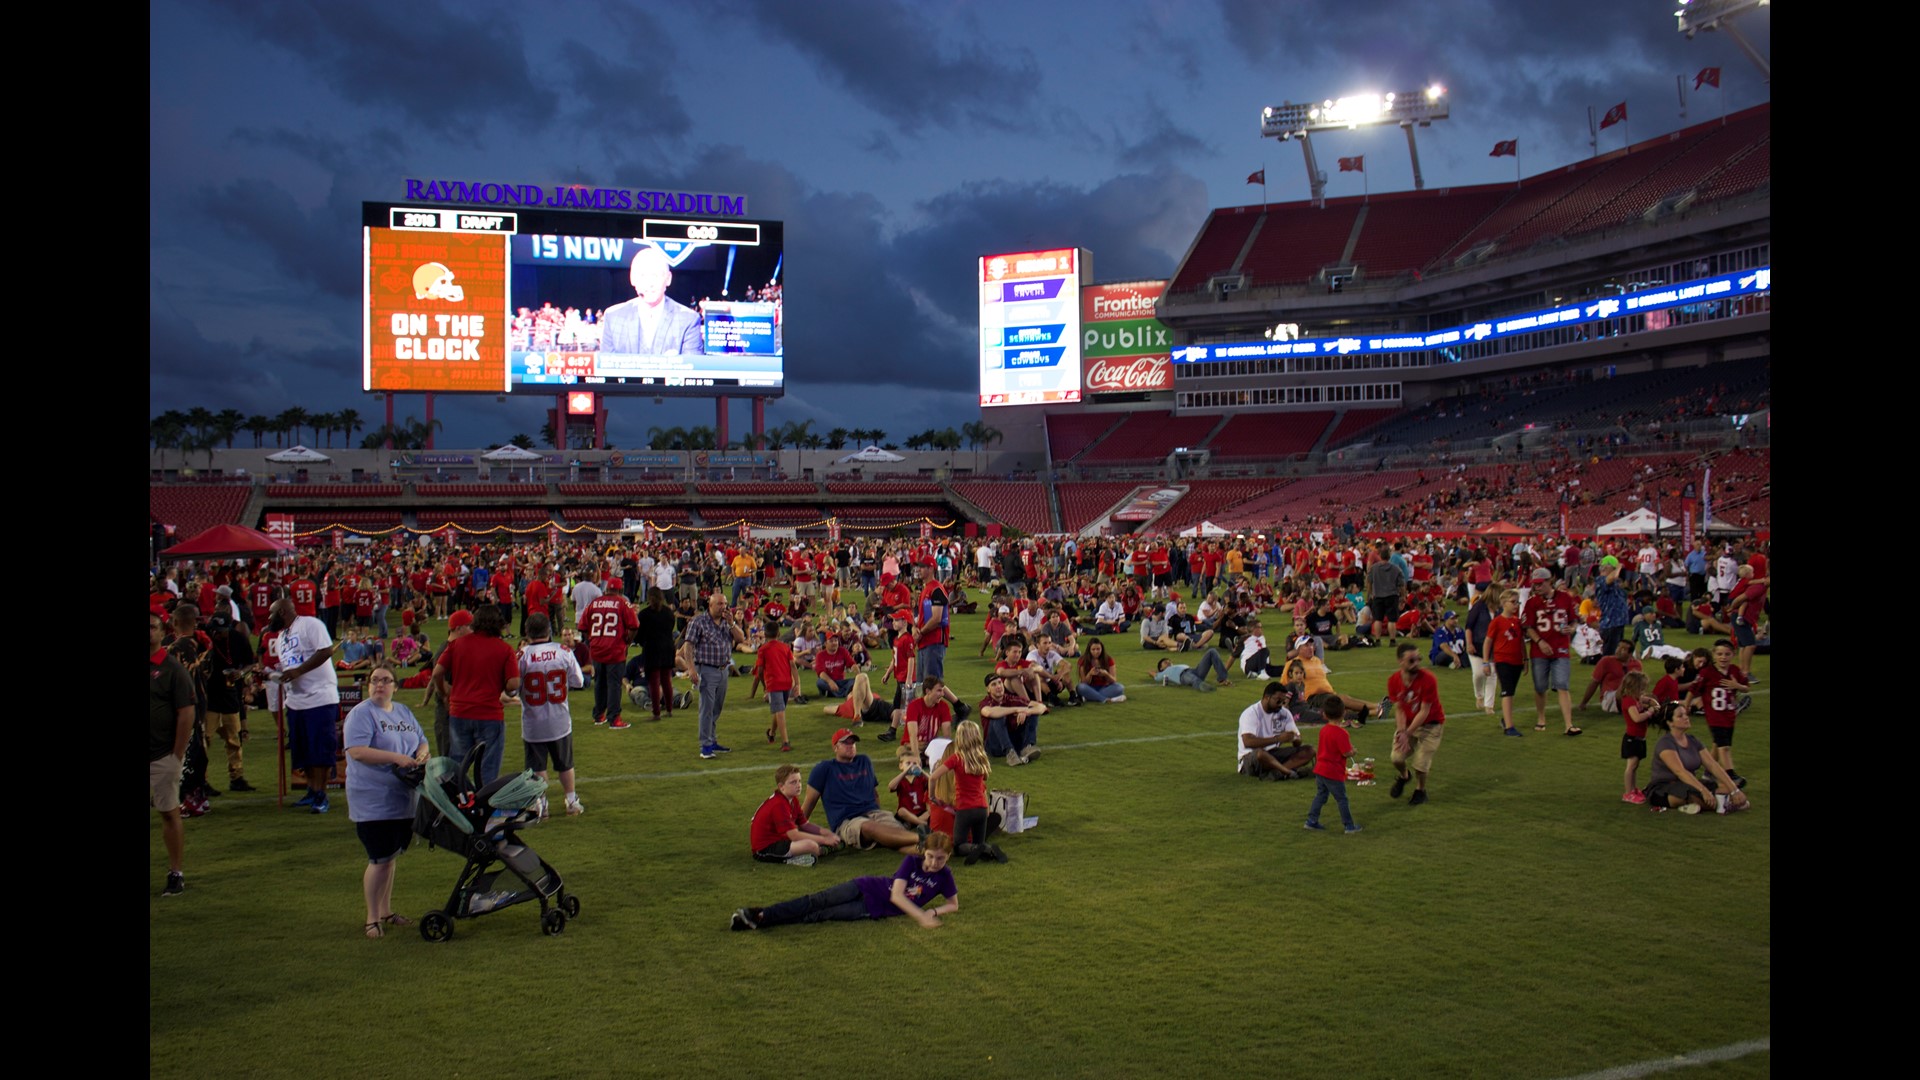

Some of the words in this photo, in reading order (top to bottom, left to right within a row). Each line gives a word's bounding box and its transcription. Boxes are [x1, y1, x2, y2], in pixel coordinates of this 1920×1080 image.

[405, 178, 544, 206] RAYMOND
[547, 186, 632, 210] JAMES
[637, 190, 745, 216] STADIUM
[461, 215, 503, 230] DRAFT
[687, 225, 718, 240] 0:00
[532, 234, 559, 259] IS
[563, 235, 624, 261] NOW
[1094, 293, 1159, 312] Frontier
[1094, 308, 1156, 319] COMMUNICATIONS
[391, 313, 428, 336] ON
[435, 314, 484, 337] THE
[1009, 332, 1051, 343] SEAHAWKS
[1084, 325, 1167, 350] Publix
[395, 337, 480, 361] CLOCK
[1011, 355, 1050, 365] COWBOYS
[1086, 357, 1170, 389] Coca-Cola
[256, 593, 268, 607] 13
[296, 589, 313, 603] 93
[591, 612, 618, 637] 22
[530, 650, 557, 663] McCOY
[338, 691, 360, 700] TORE
[524, 669, 567, 707] 93
